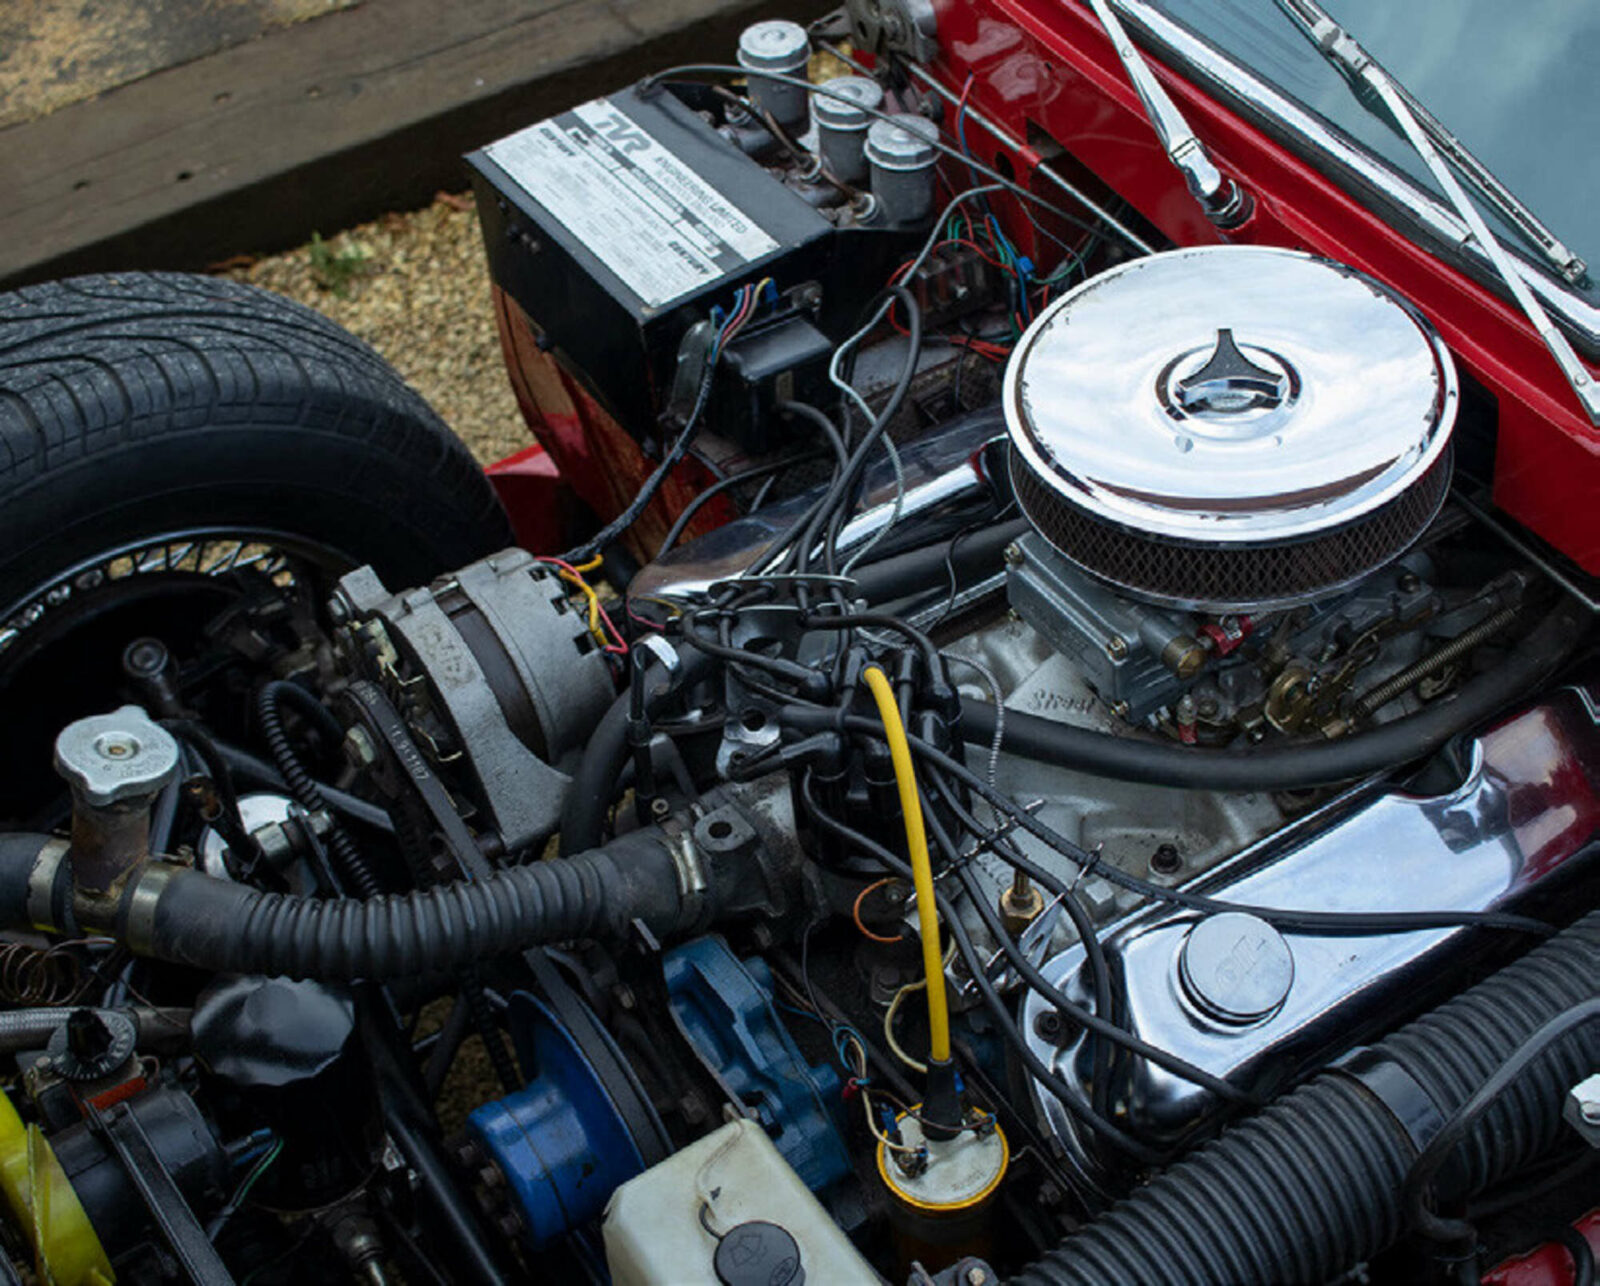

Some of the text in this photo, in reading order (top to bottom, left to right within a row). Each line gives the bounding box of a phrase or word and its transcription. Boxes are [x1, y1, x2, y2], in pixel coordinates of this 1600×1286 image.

[594, 112, 653, 156] TVR
[653, 155, 714, 203] ENGINEERING
[708, 202, 749, 233] LIMITED
[668, 241, 710, 275] CENTURY
